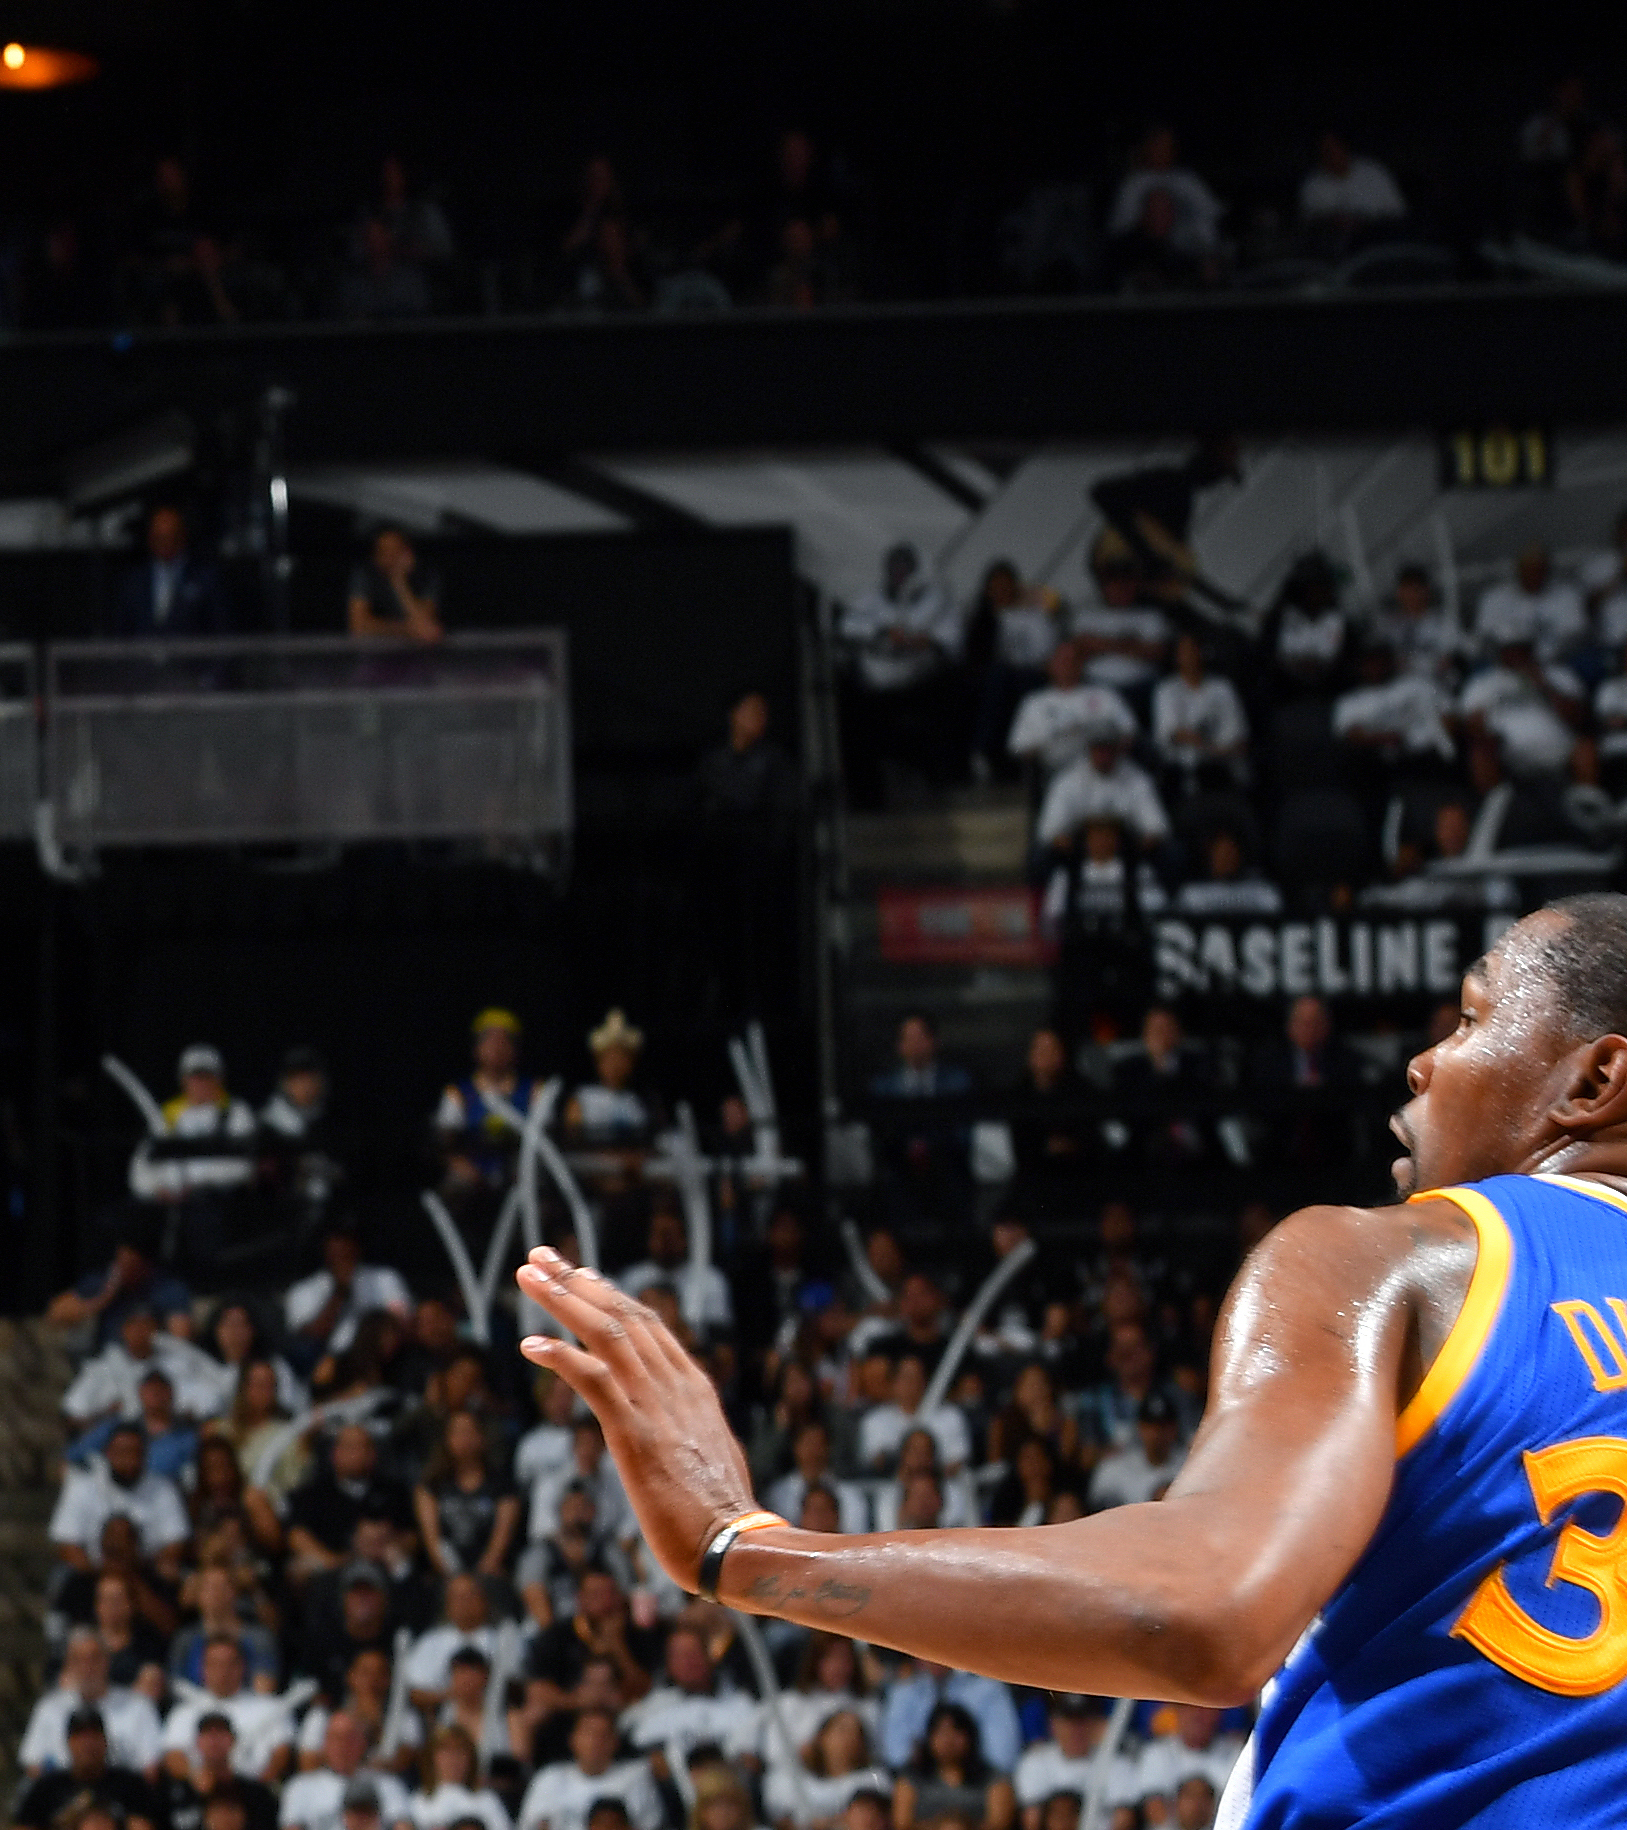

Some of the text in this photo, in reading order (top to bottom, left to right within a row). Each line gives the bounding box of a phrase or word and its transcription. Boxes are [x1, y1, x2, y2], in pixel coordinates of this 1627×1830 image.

[1453, 429, 1546, 485] 101
[1154, 916, 1459, 998] BASELINE
[1550, 1297, 1627, 1393] D
